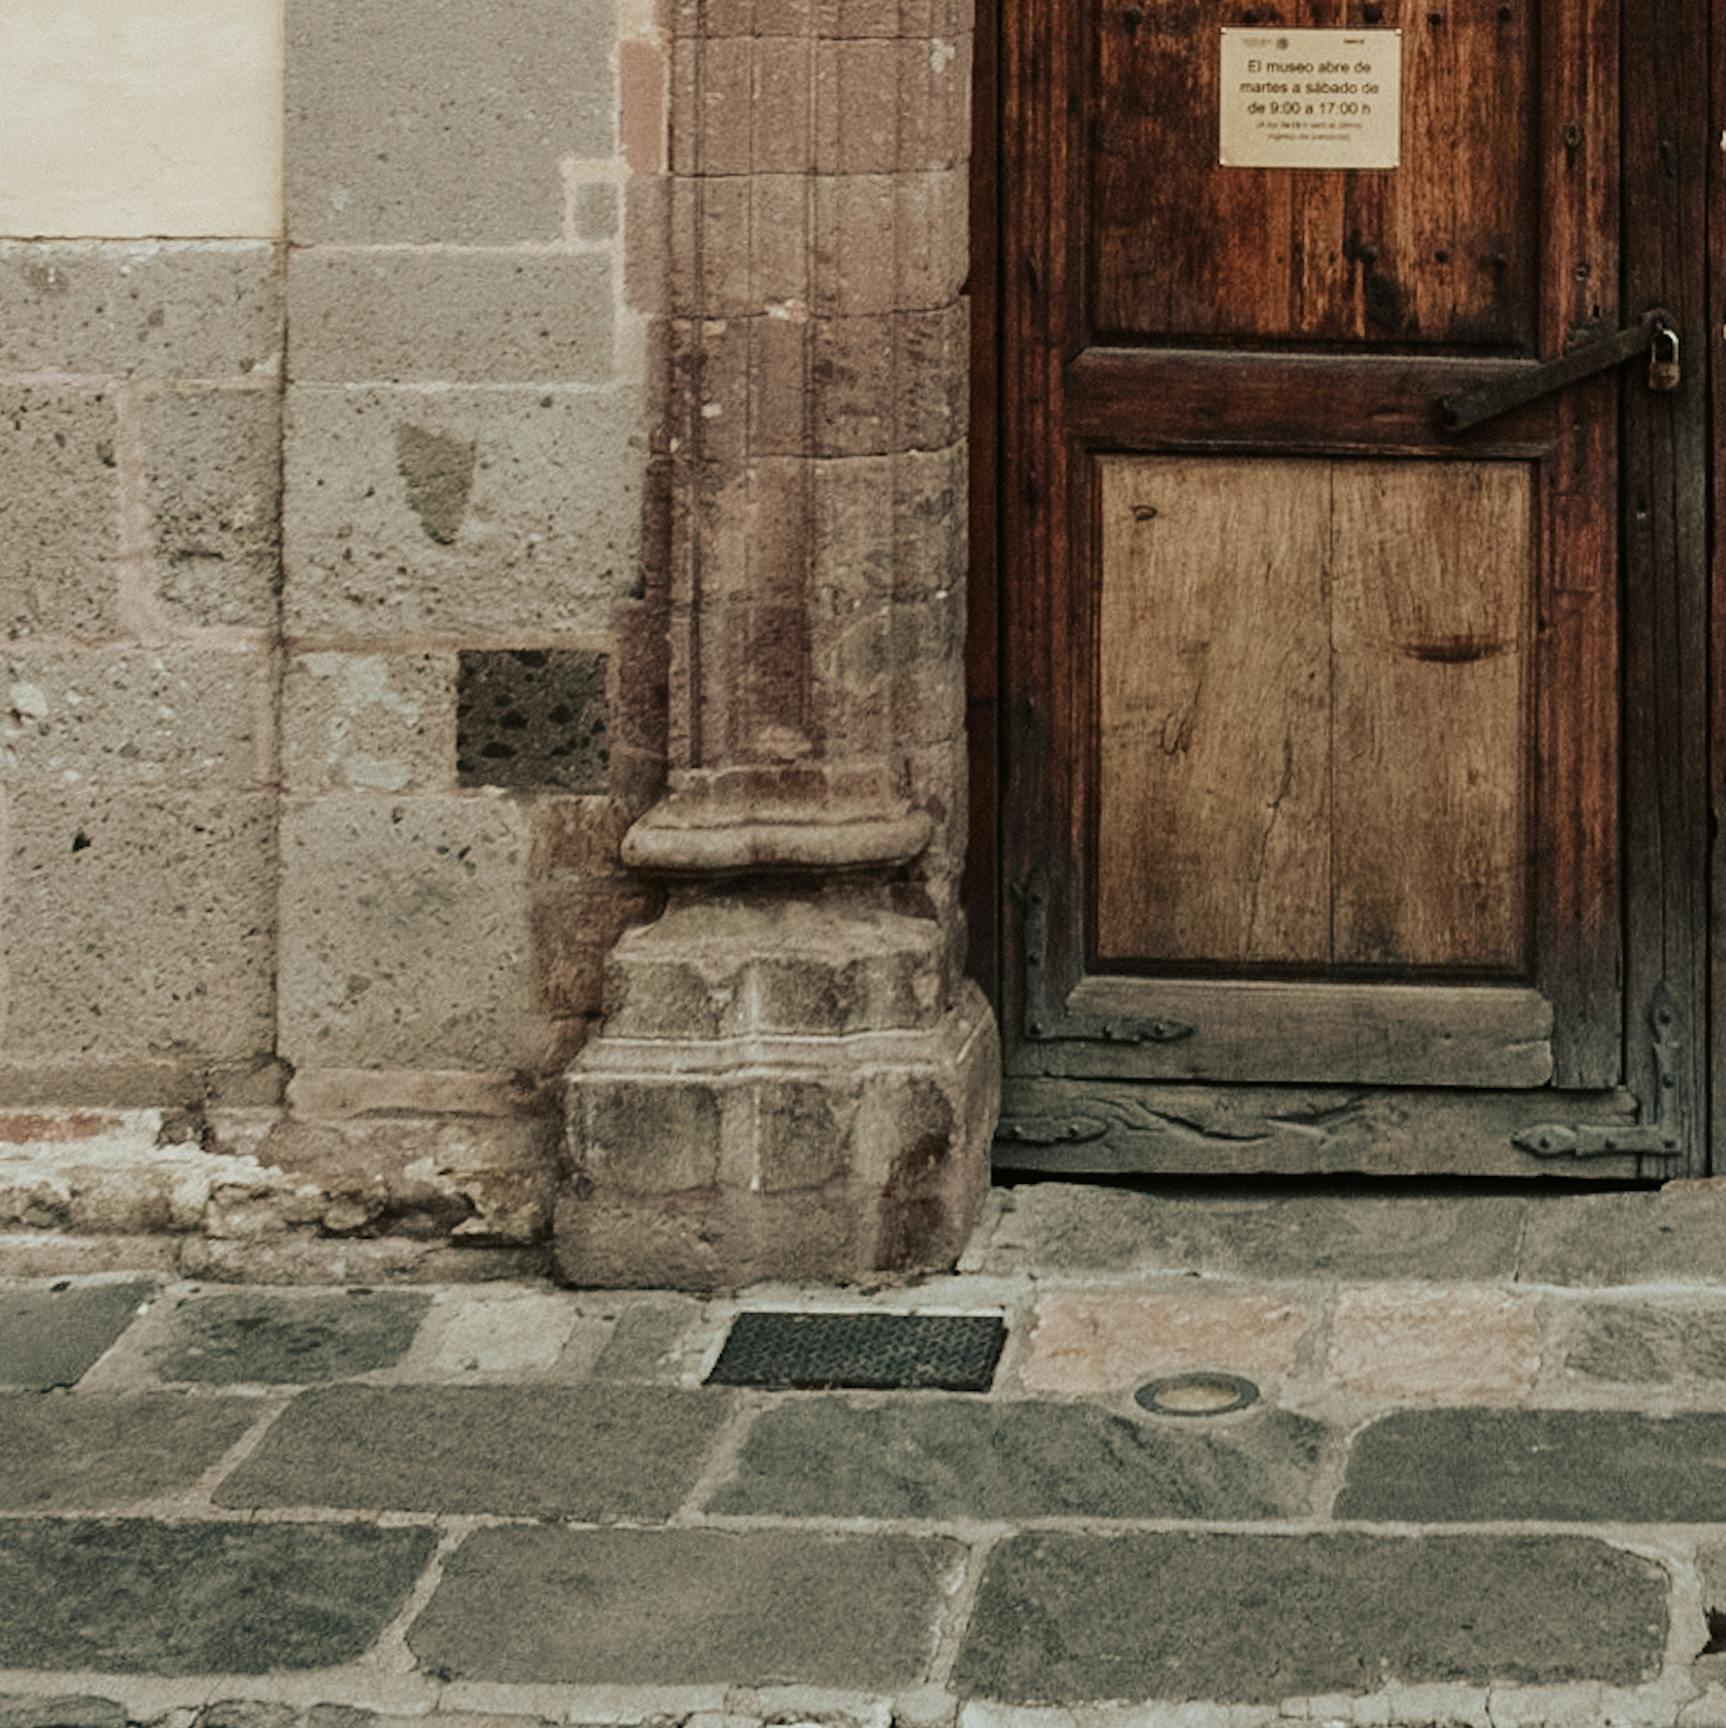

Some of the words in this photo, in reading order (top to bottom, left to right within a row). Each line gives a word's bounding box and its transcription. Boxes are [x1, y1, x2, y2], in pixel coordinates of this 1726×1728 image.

[1247, 59, 1262, 73] El
[1266, 61, 1314, 73] museo
[1317, 60, 1351, 73] abre
[1353, 60, 1372, 73] de
[1239, 82, 1288, 94] martes
[1291, 83, 1301, 94] a
[1305, 80, 1358, 94] sábado
[1361, 81, 1380, 94] de
[1246, 101, 1266, 114] de
[1304, 104, 1314, 114] a
[1361, 101, 1372, 114] h
